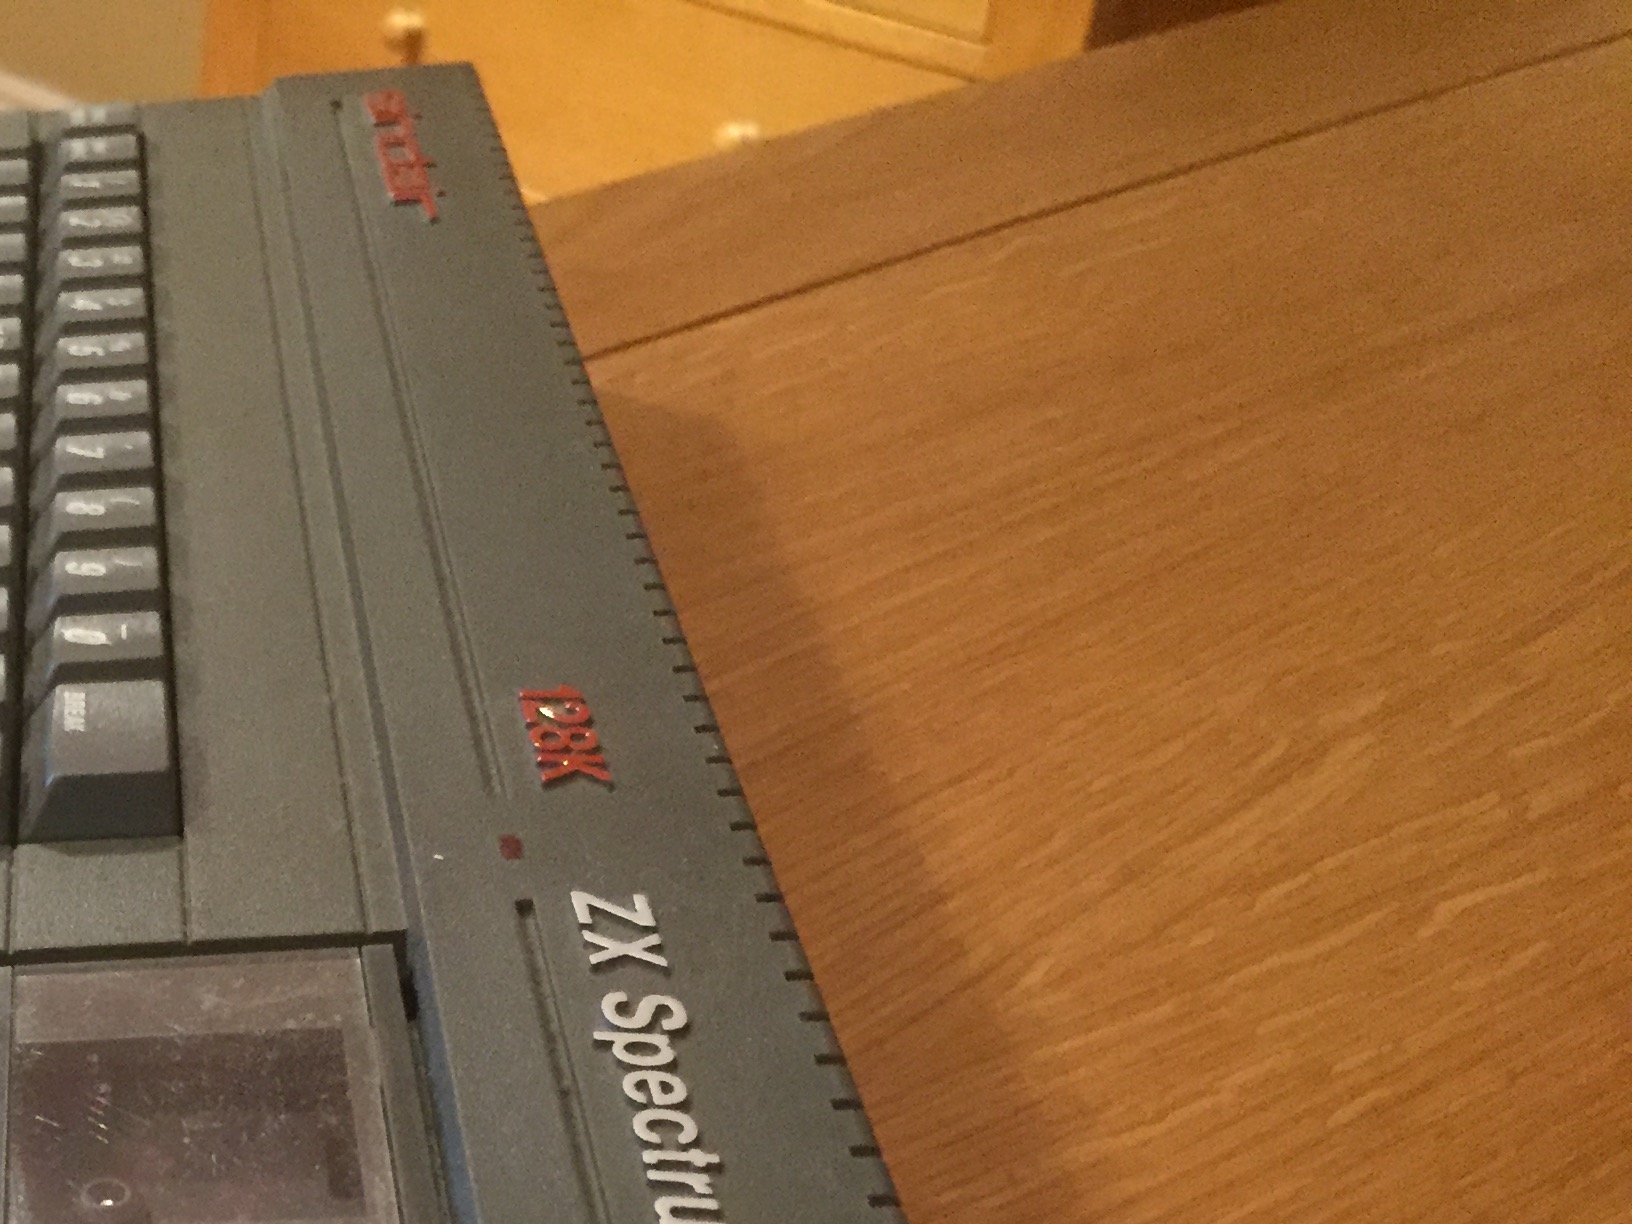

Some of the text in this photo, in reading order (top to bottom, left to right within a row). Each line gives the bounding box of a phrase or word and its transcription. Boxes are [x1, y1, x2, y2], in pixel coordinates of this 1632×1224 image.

[70, 299, 103, 310] 4
[66, 392, 104, 405] 6
[66, 446, 105, 458] 7
[66, 501, 106, 515] 8
[65, 561, 107, 576] 9
[63, 691, 86, 732] BREAK
[519, 684, 611, 781] 128K
[570, 890, 668, 967] ZX
